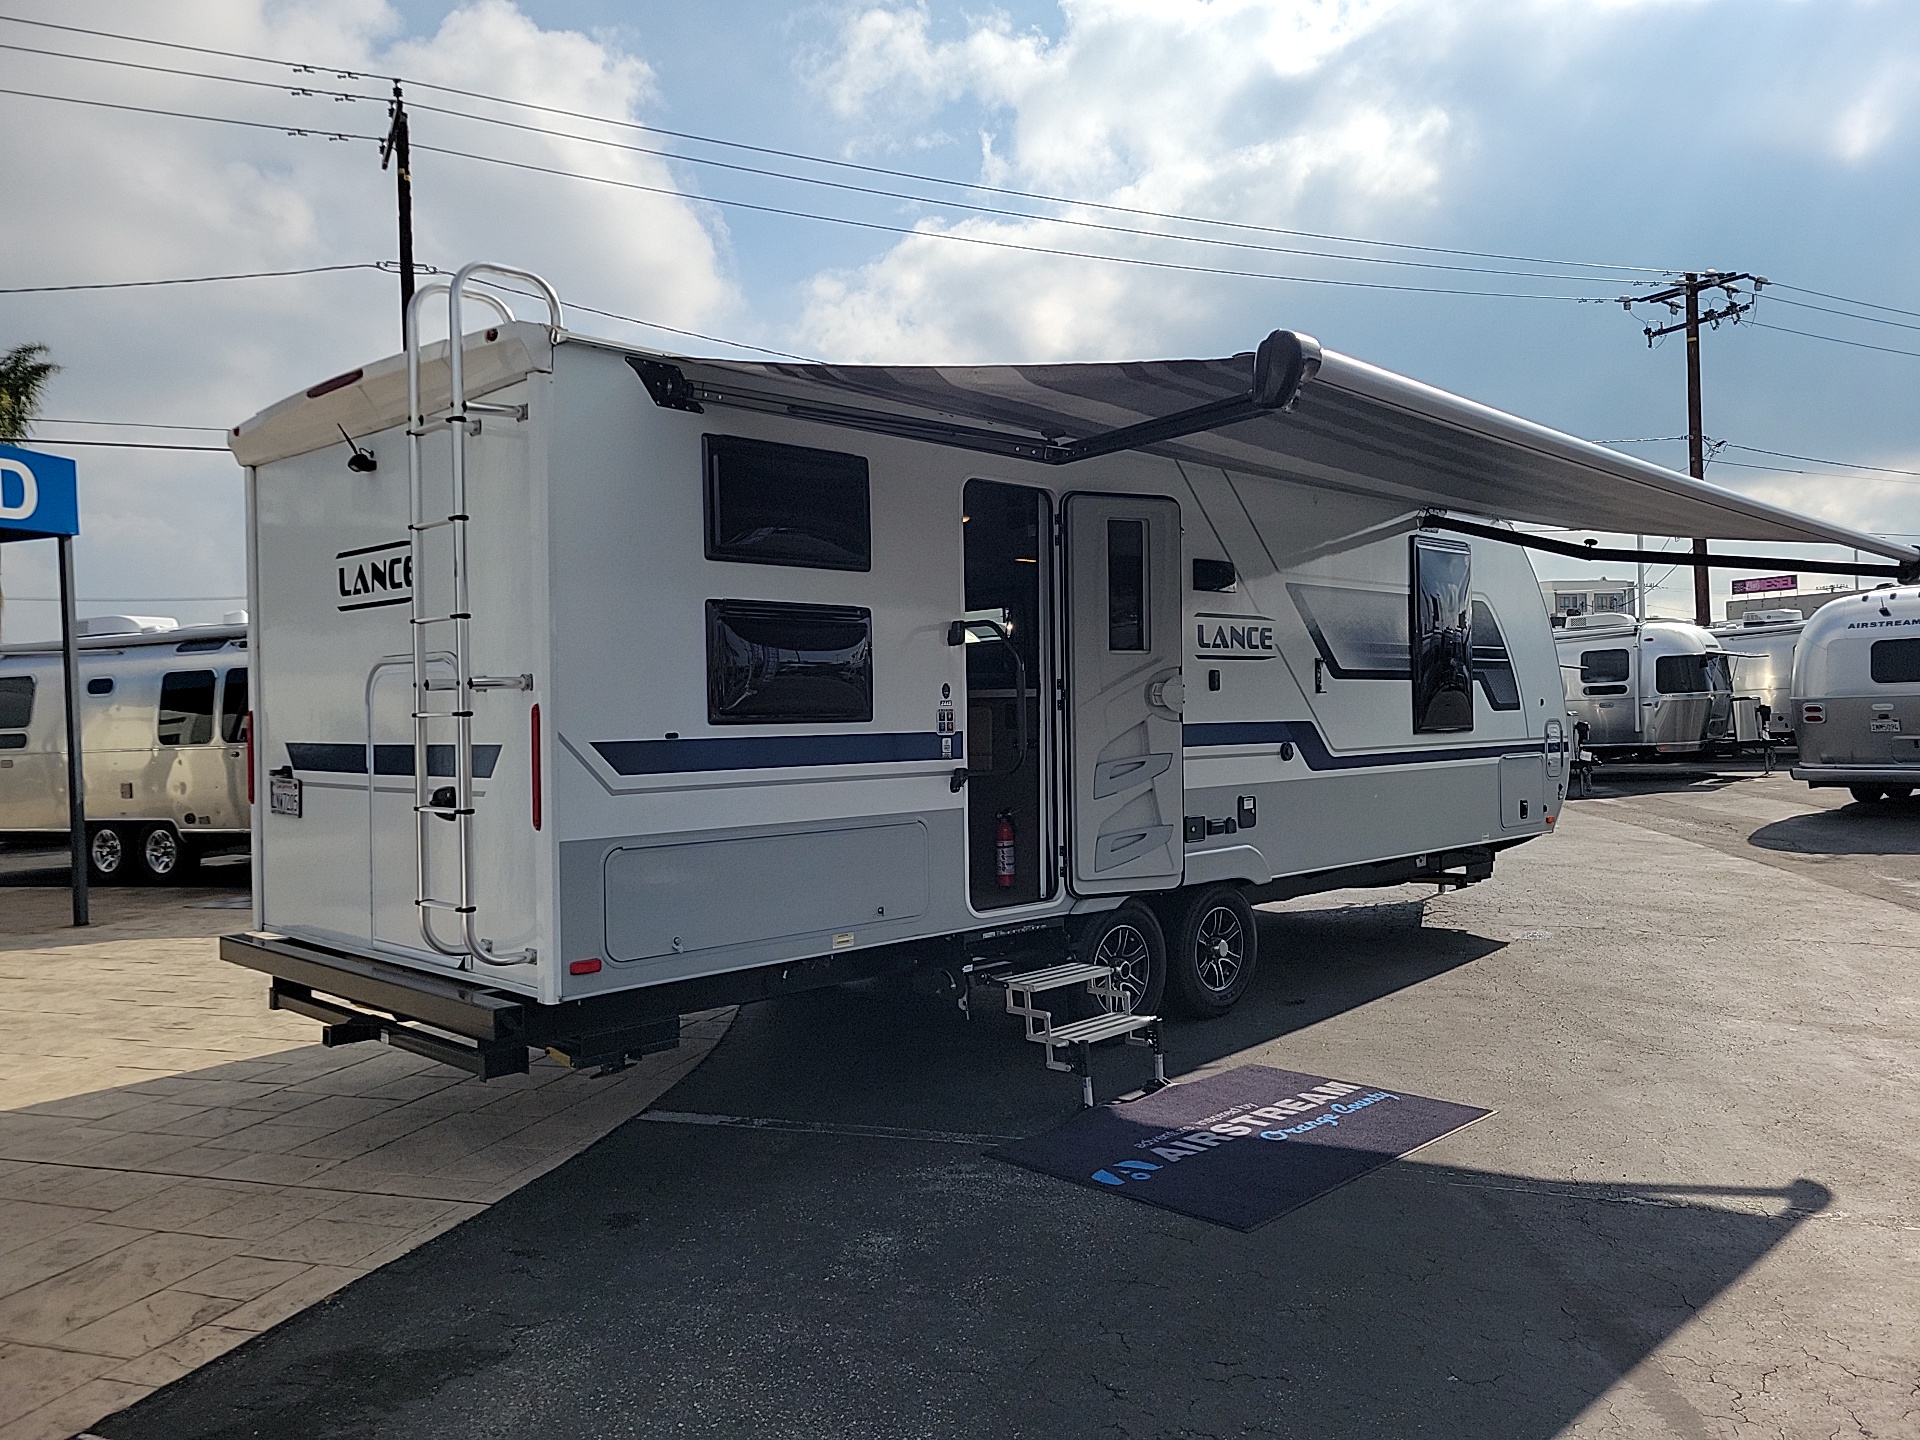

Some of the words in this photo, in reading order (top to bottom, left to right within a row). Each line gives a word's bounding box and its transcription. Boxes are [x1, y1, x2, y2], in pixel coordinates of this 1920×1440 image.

[0, 457, 39, 520] D
[338, 555, 412, 597] LANCE
[1197, 624, 1273, 650] LANCE
[1847, 618, 1920, 629] AIRSTREAM
[1150, 1081, 1362, 1163] AIRSTREAM
[1260, 1112, 1340, 1142] Orange
[1330, 1090, 1400, 1115] County
